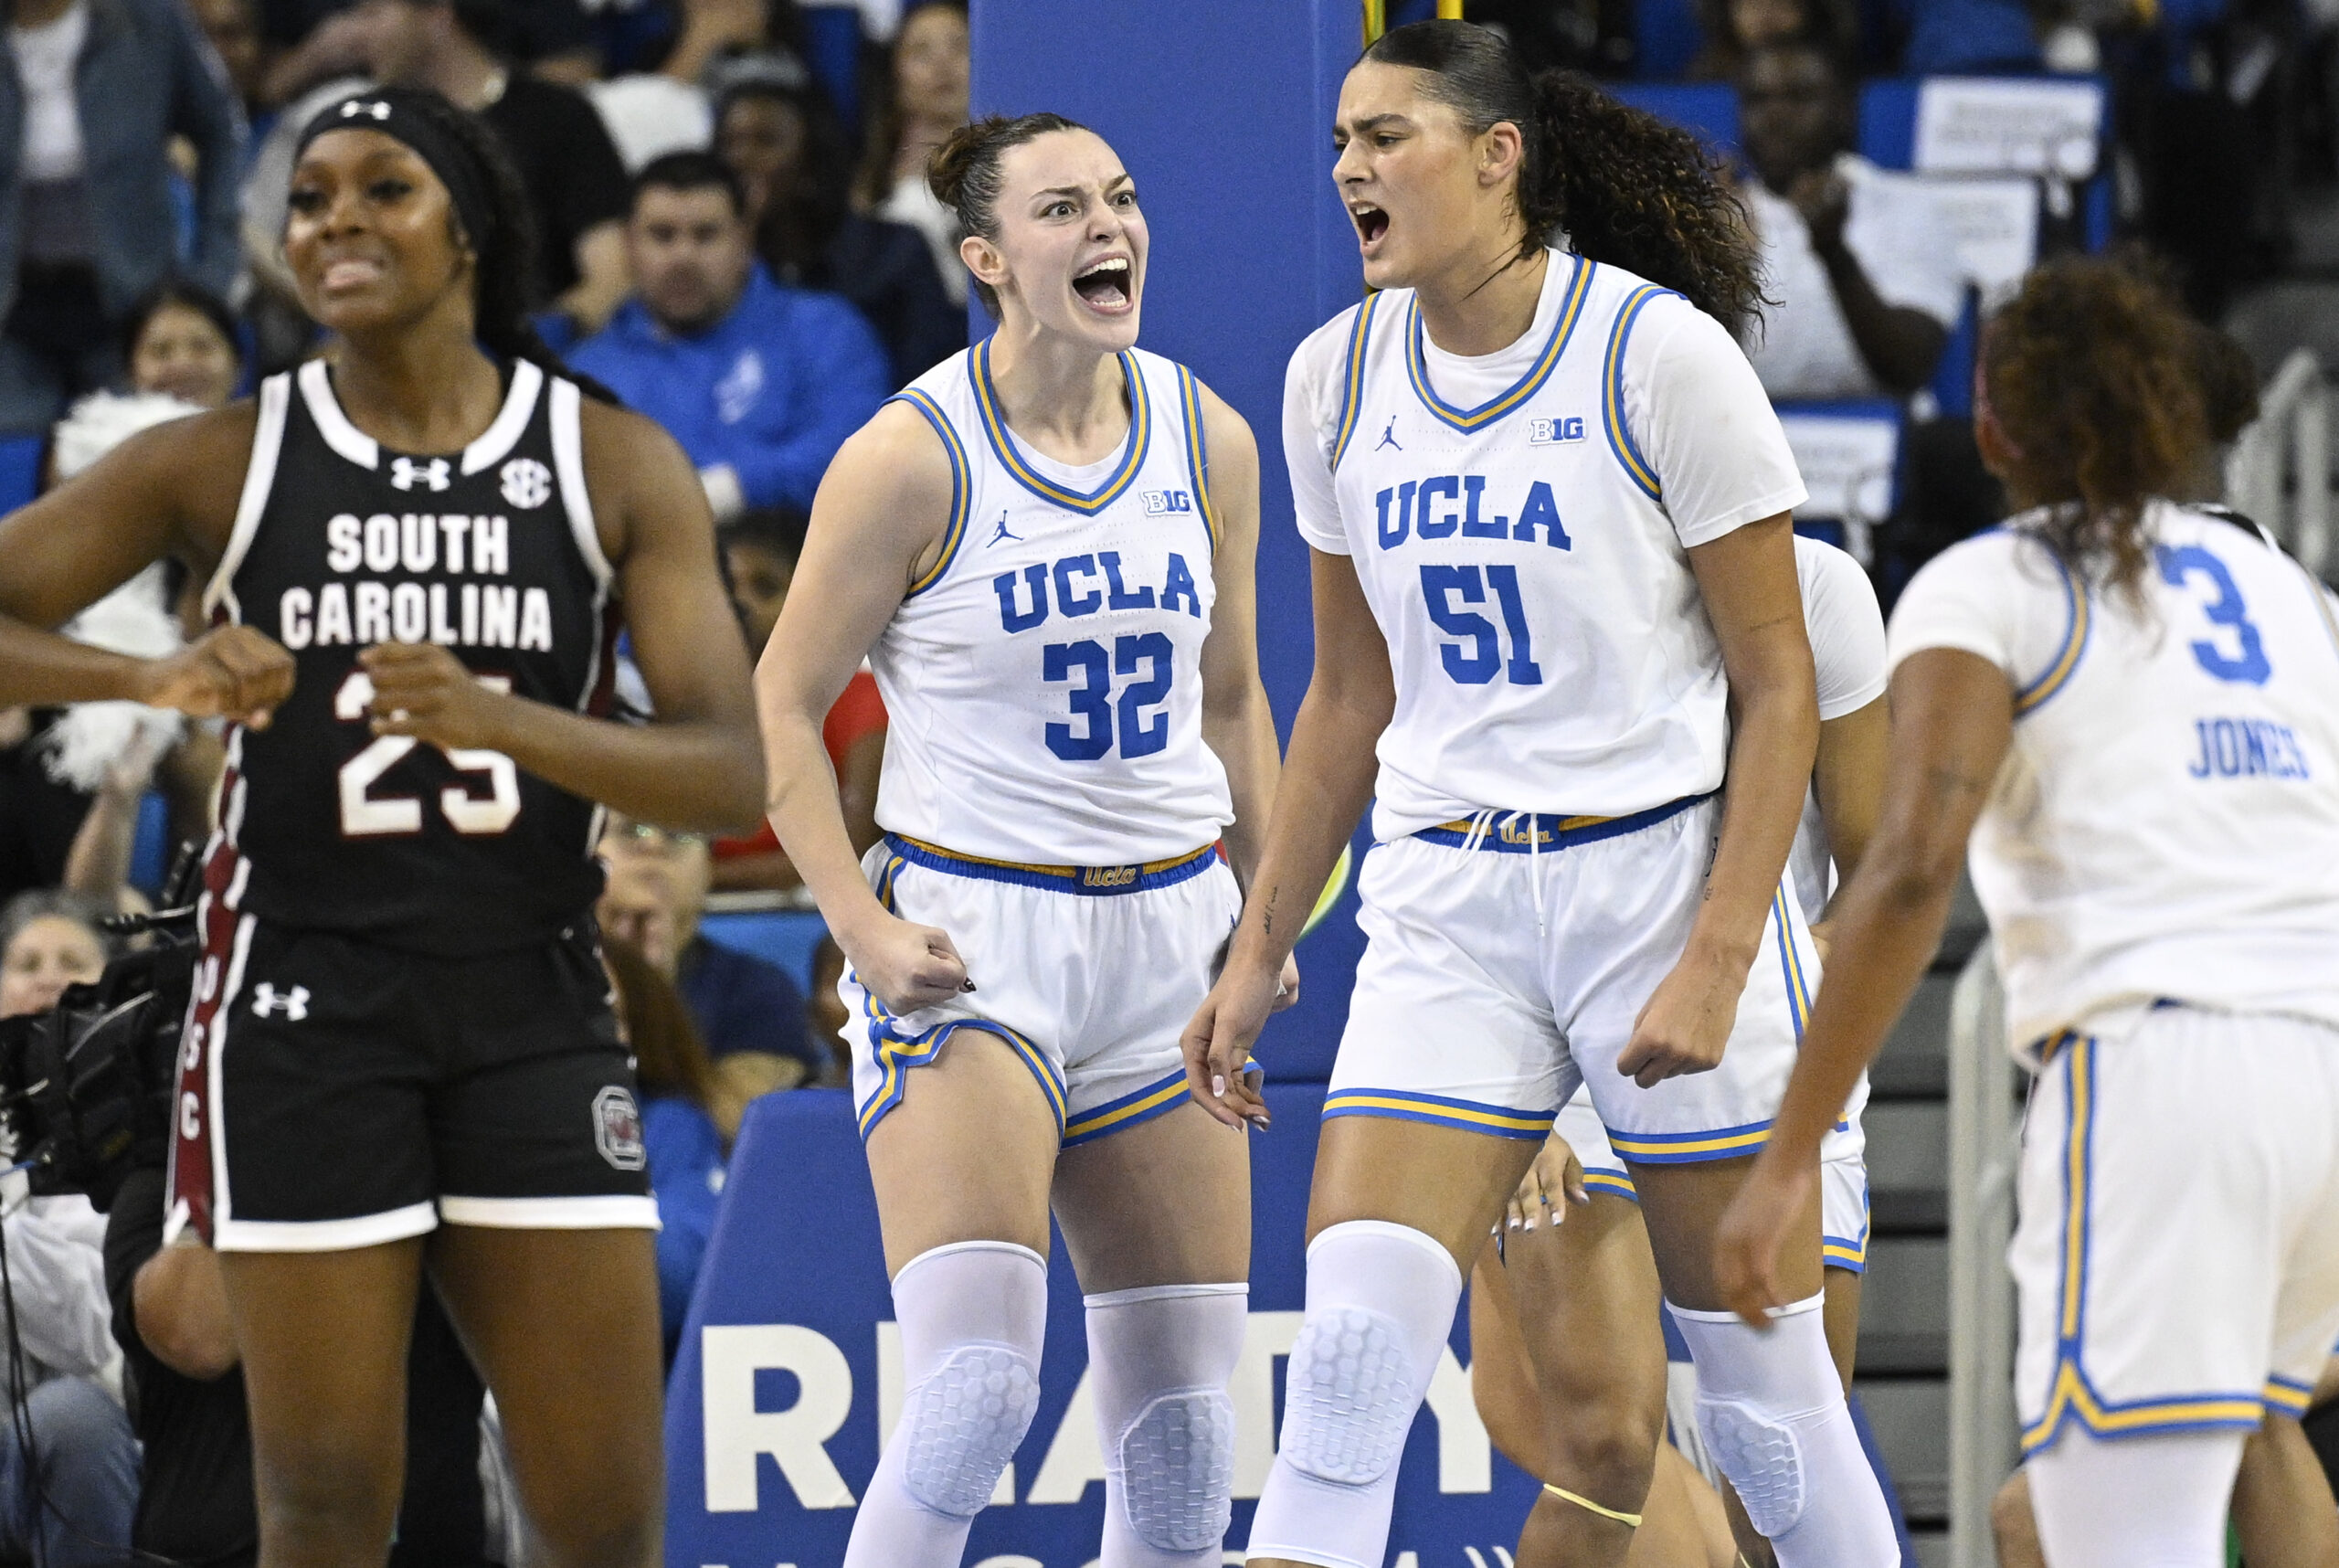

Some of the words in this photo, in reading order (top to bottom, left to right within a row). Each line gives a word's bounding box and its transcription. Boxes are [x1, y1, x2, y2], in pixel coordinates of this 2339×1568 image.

[327, 514, 508, 574] SOUTH
[1376, 475, 1572, 552] UCLA
[280, 581, 553, 652] CAROLINA
[993, 551, 1201, 634] UCLA
[1420, 565, 1543, 685] 51
[2154, 543, 2272, 685] 3
[1043, 631, 1173, 760] 32
[334, 672, 521, 835] 25
[2189, 718, 2311, 781] JONES
